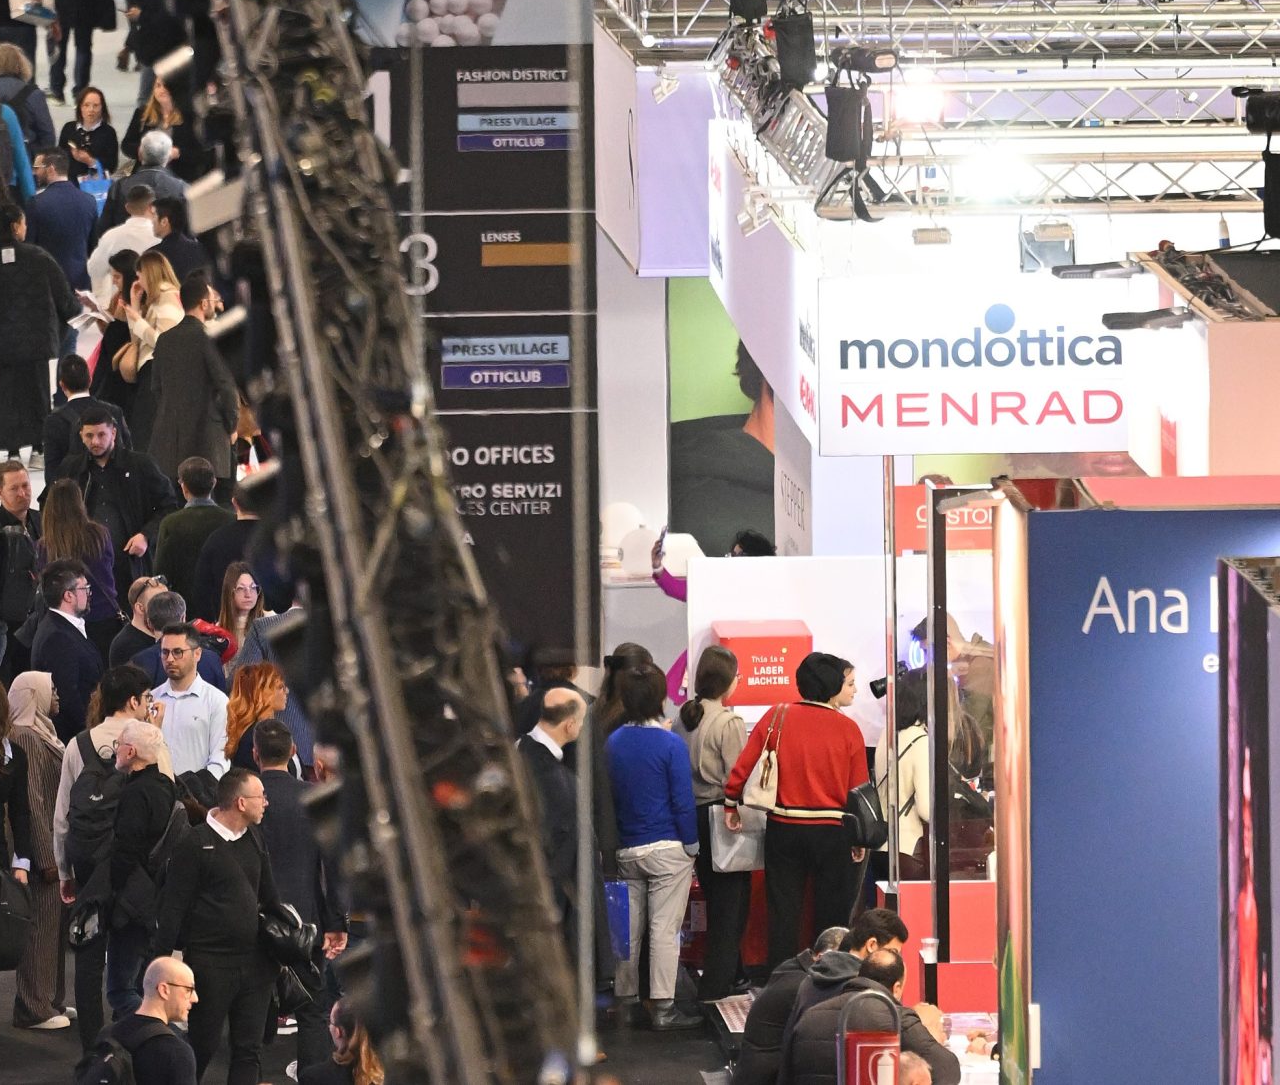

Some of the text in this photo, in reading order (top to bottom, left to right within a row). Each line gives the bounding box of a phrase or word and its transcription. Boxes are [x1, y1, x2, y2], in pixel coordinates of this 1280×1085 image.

[457, 70, 510, 82] FASHION
[512, 69, 568, 81] DISTRICT
[479, 117, 557, 127] PRESS VILLAGE
[492, 137, 545, 148] OTTICLUB
[398, 232, 522, 296] 3 LENSES
[840, 304, 1123, 369] mondottica
[452, 343, 559, 356] PRESS VILLAGE
[470, 370, 542, 384] OTTICLUB
[841, 390, 1124, 428] MENRAD
[474, 446, 555, 464] OFFICES
[492, 484, 562, 498] SERVIZI
[490, 501, 551, 515] CENTER
[1081, 576, 1189, 634] Ana
[754, 666, 784, 675] LASER
[747, 676, 790, 686] MACHINE
